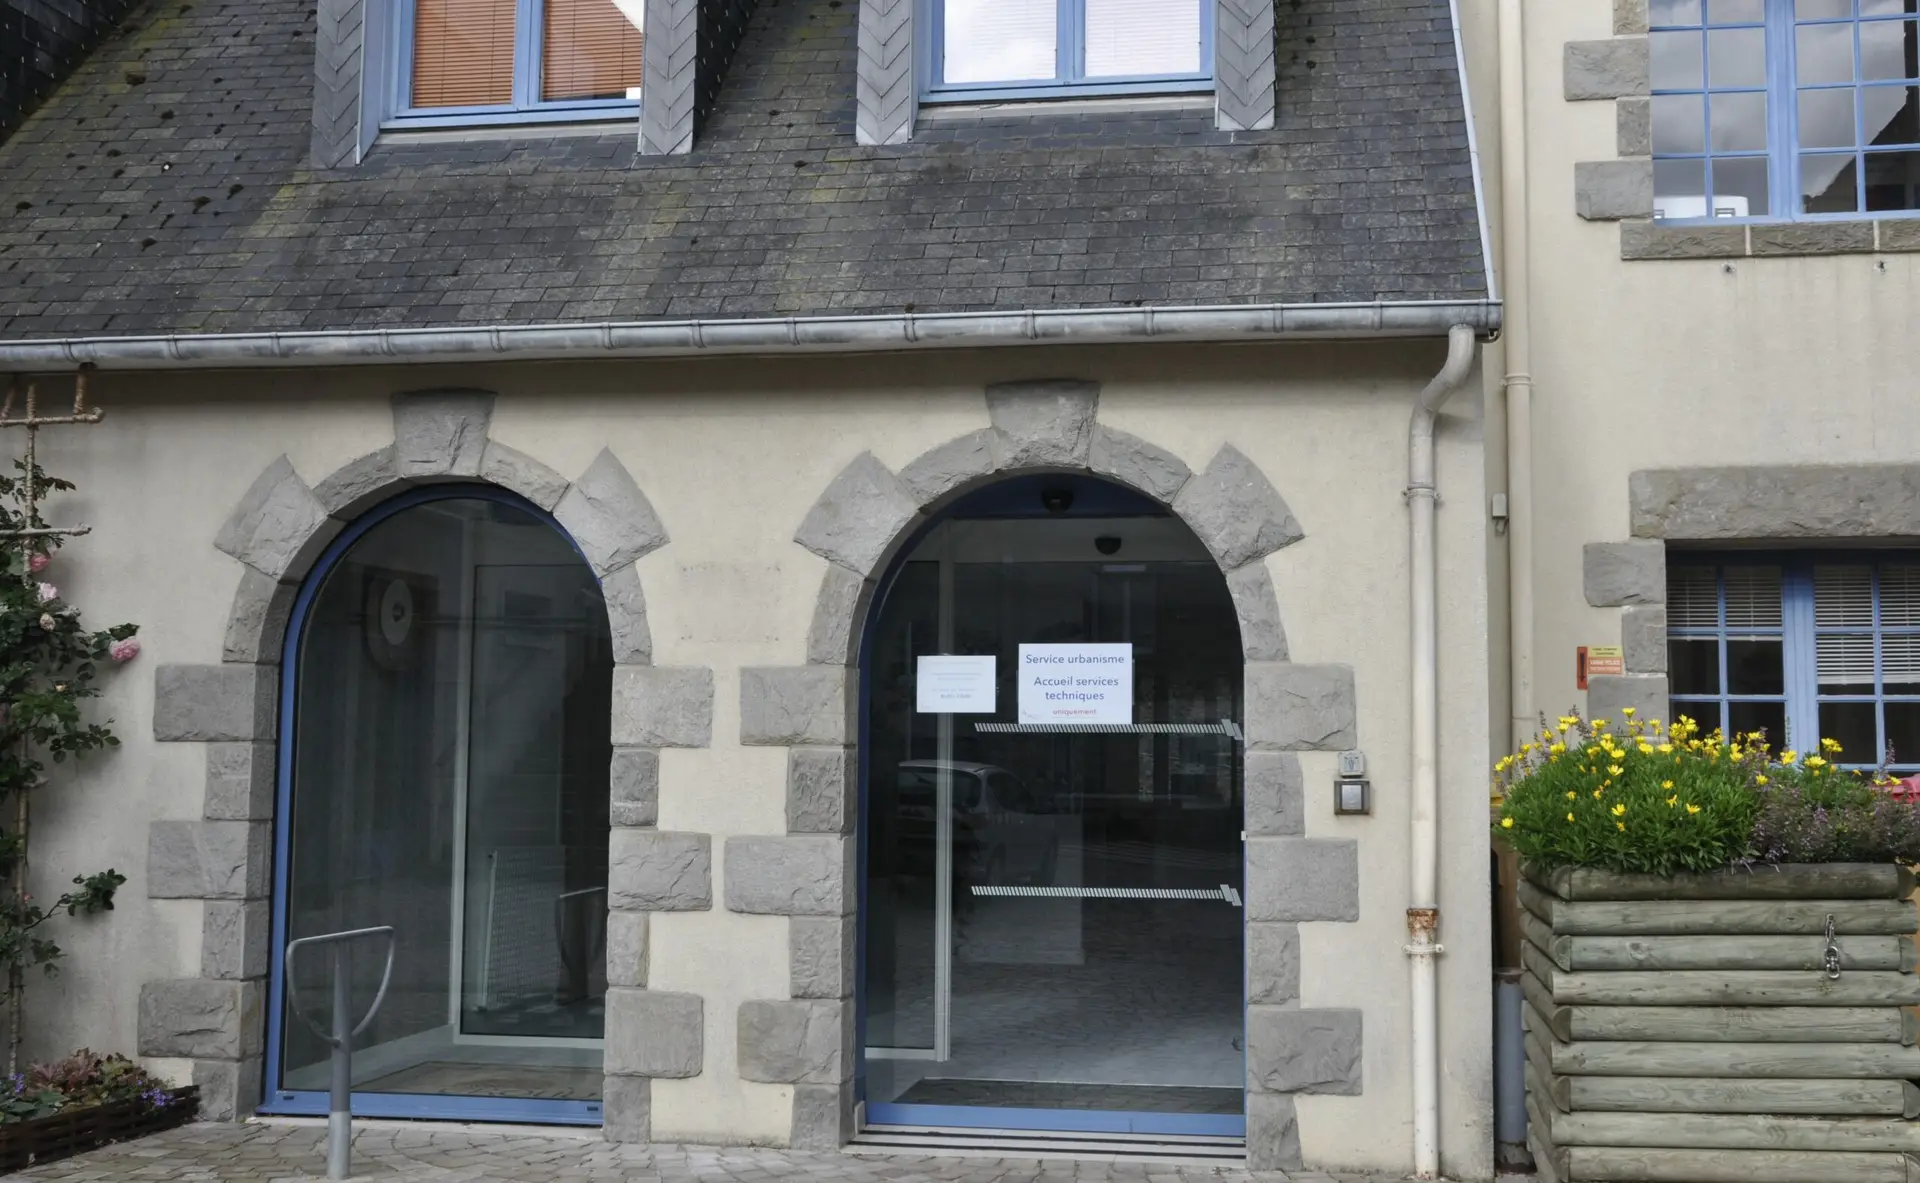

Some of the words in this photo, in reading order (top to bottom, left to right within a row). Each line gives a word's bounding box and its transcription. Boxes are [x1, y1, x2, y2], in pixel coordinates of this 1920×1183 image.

[1025, 654, 1065, 664] Service
[1067, 653, 1125, 664] urbanisme
[1033, 676, 1073, 686] Accueil
[1076, 676, 1119, 686] services
[1045, 690, 1105, 702] techniques
[1052, 708, 1097, 716] uniquement
